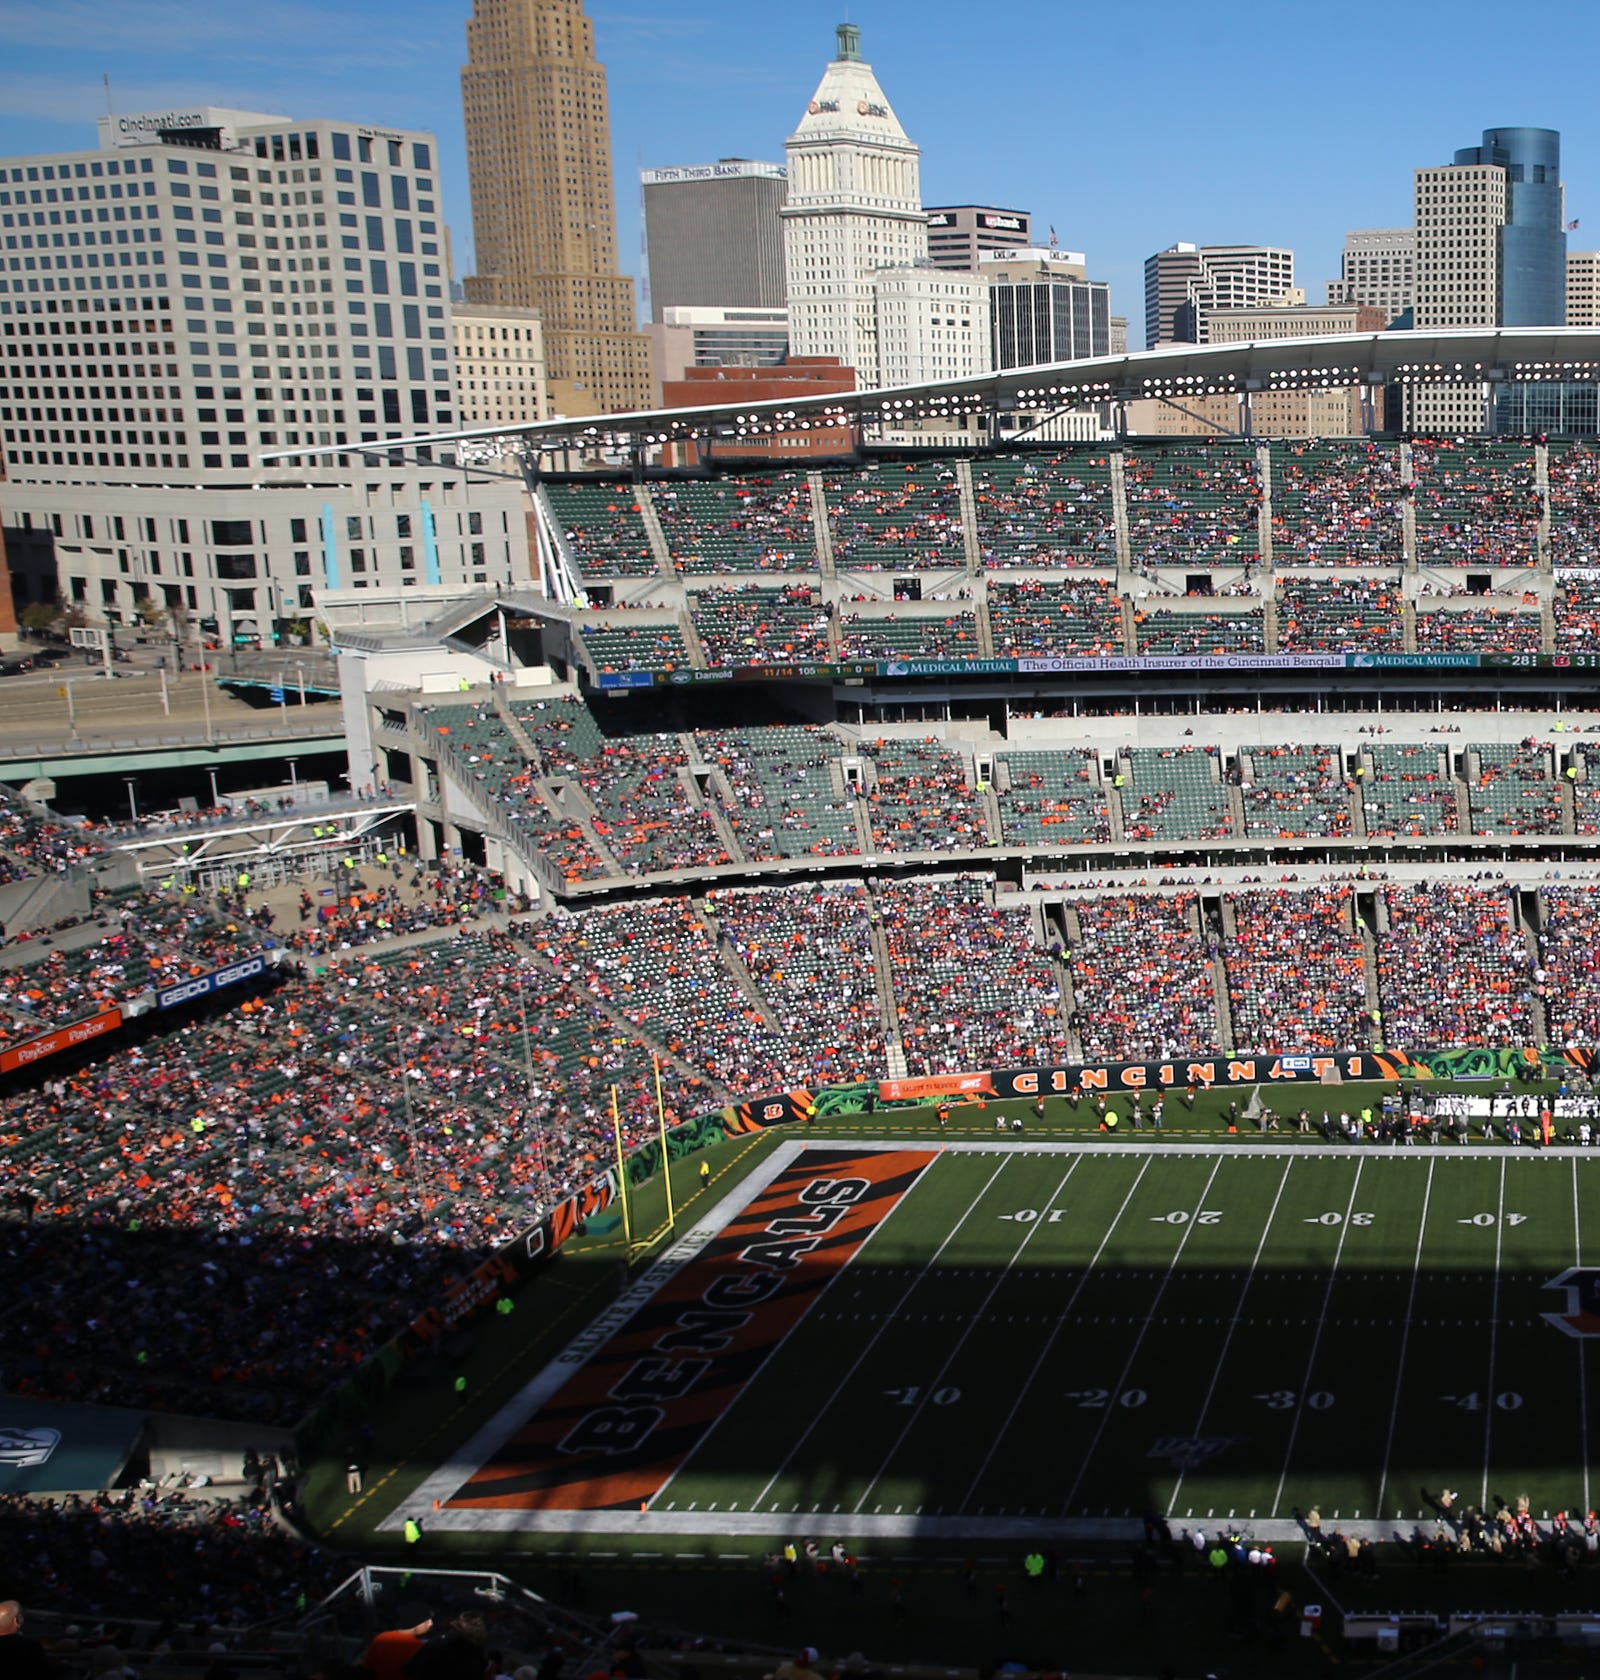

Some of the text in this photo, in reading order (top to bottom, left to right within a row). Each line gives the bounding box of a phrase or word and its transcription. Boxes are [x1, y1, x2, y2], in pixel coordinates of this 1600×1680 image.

[119, 111, 203, 132] Cincinnati.com
[655, 164, 741, 181] FIFTH THIRD BANK
[799, 666, 816, 675] 105
[856, 665, 862, 673] 0
[910, 661, 1012, 673] MEDICAL MUTUAL
[1024, 656, 1341, 670] The Official Health Insurer of the Cincinnati Bengals
[1376, 656, 1471, 665] MEDICAL MUTUAL
[1511, 656, 1529, 666] 28
[1577, 656, 1586, 666] 3
[695, 671, 732, 680] Darnold
[215, 958, 263, 988] GEICO
[160, 978, 210, 1007] GEICO
[68, 1021, 107, 1043] Paycor
[18, 1040, 57, 1063] Paycor
[556, 1176, 872, 1456] BENGALS
[558, 1307, 635, 1363] SALUTE
[900, 1386, 962, 1406] 10
[1078, 1388, 1148, 1408] 20
[1266, 1390, 1336, 1410] 30
[1456, 1391, 1524, 1411] 40
